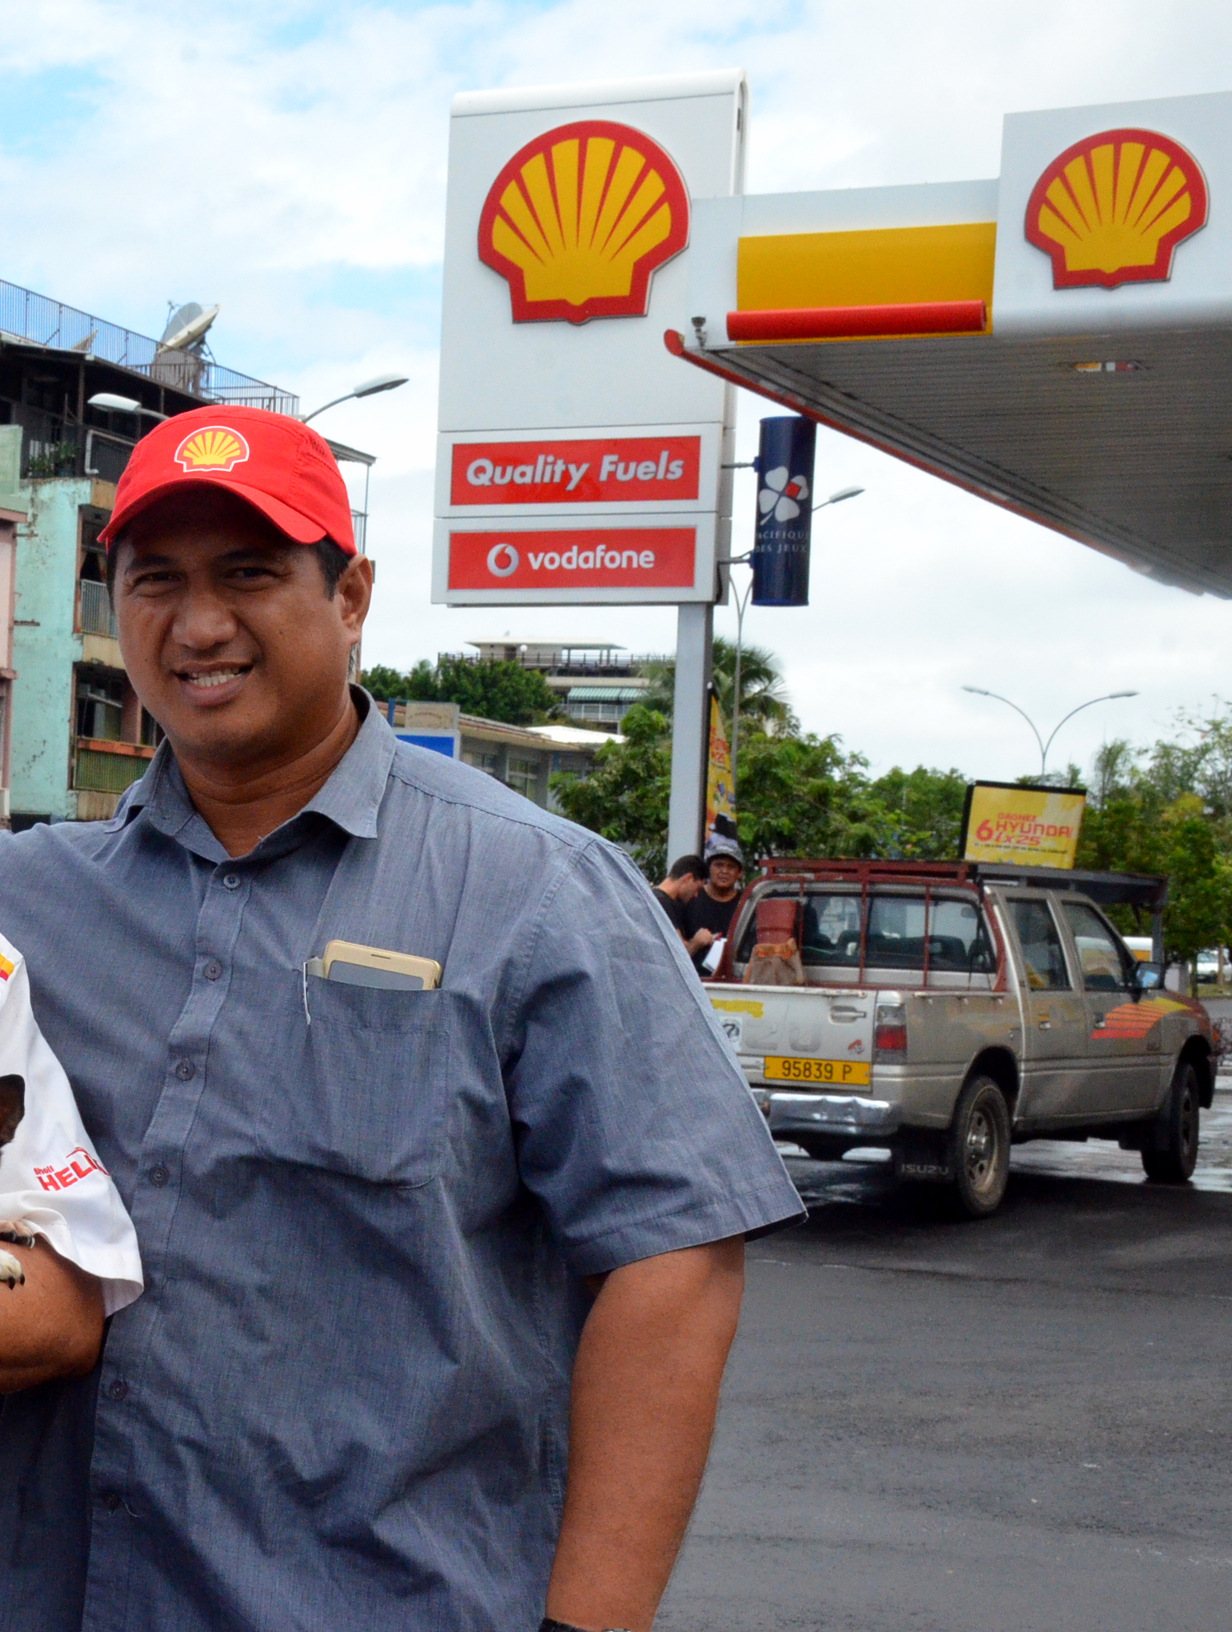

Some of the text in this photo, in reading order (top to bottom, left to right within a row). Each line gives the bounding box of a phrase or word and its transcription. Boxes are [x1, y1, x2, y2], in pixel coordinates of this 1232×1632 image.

[467, 450, 685, 491] Quality Fuels
[528, 544, 655, 570] vodafone
[976, 819, 994, 842] 6
[782, 1060, 853, 1081] 95839 P
[901, 1164, 949, 1176] ISUZU
